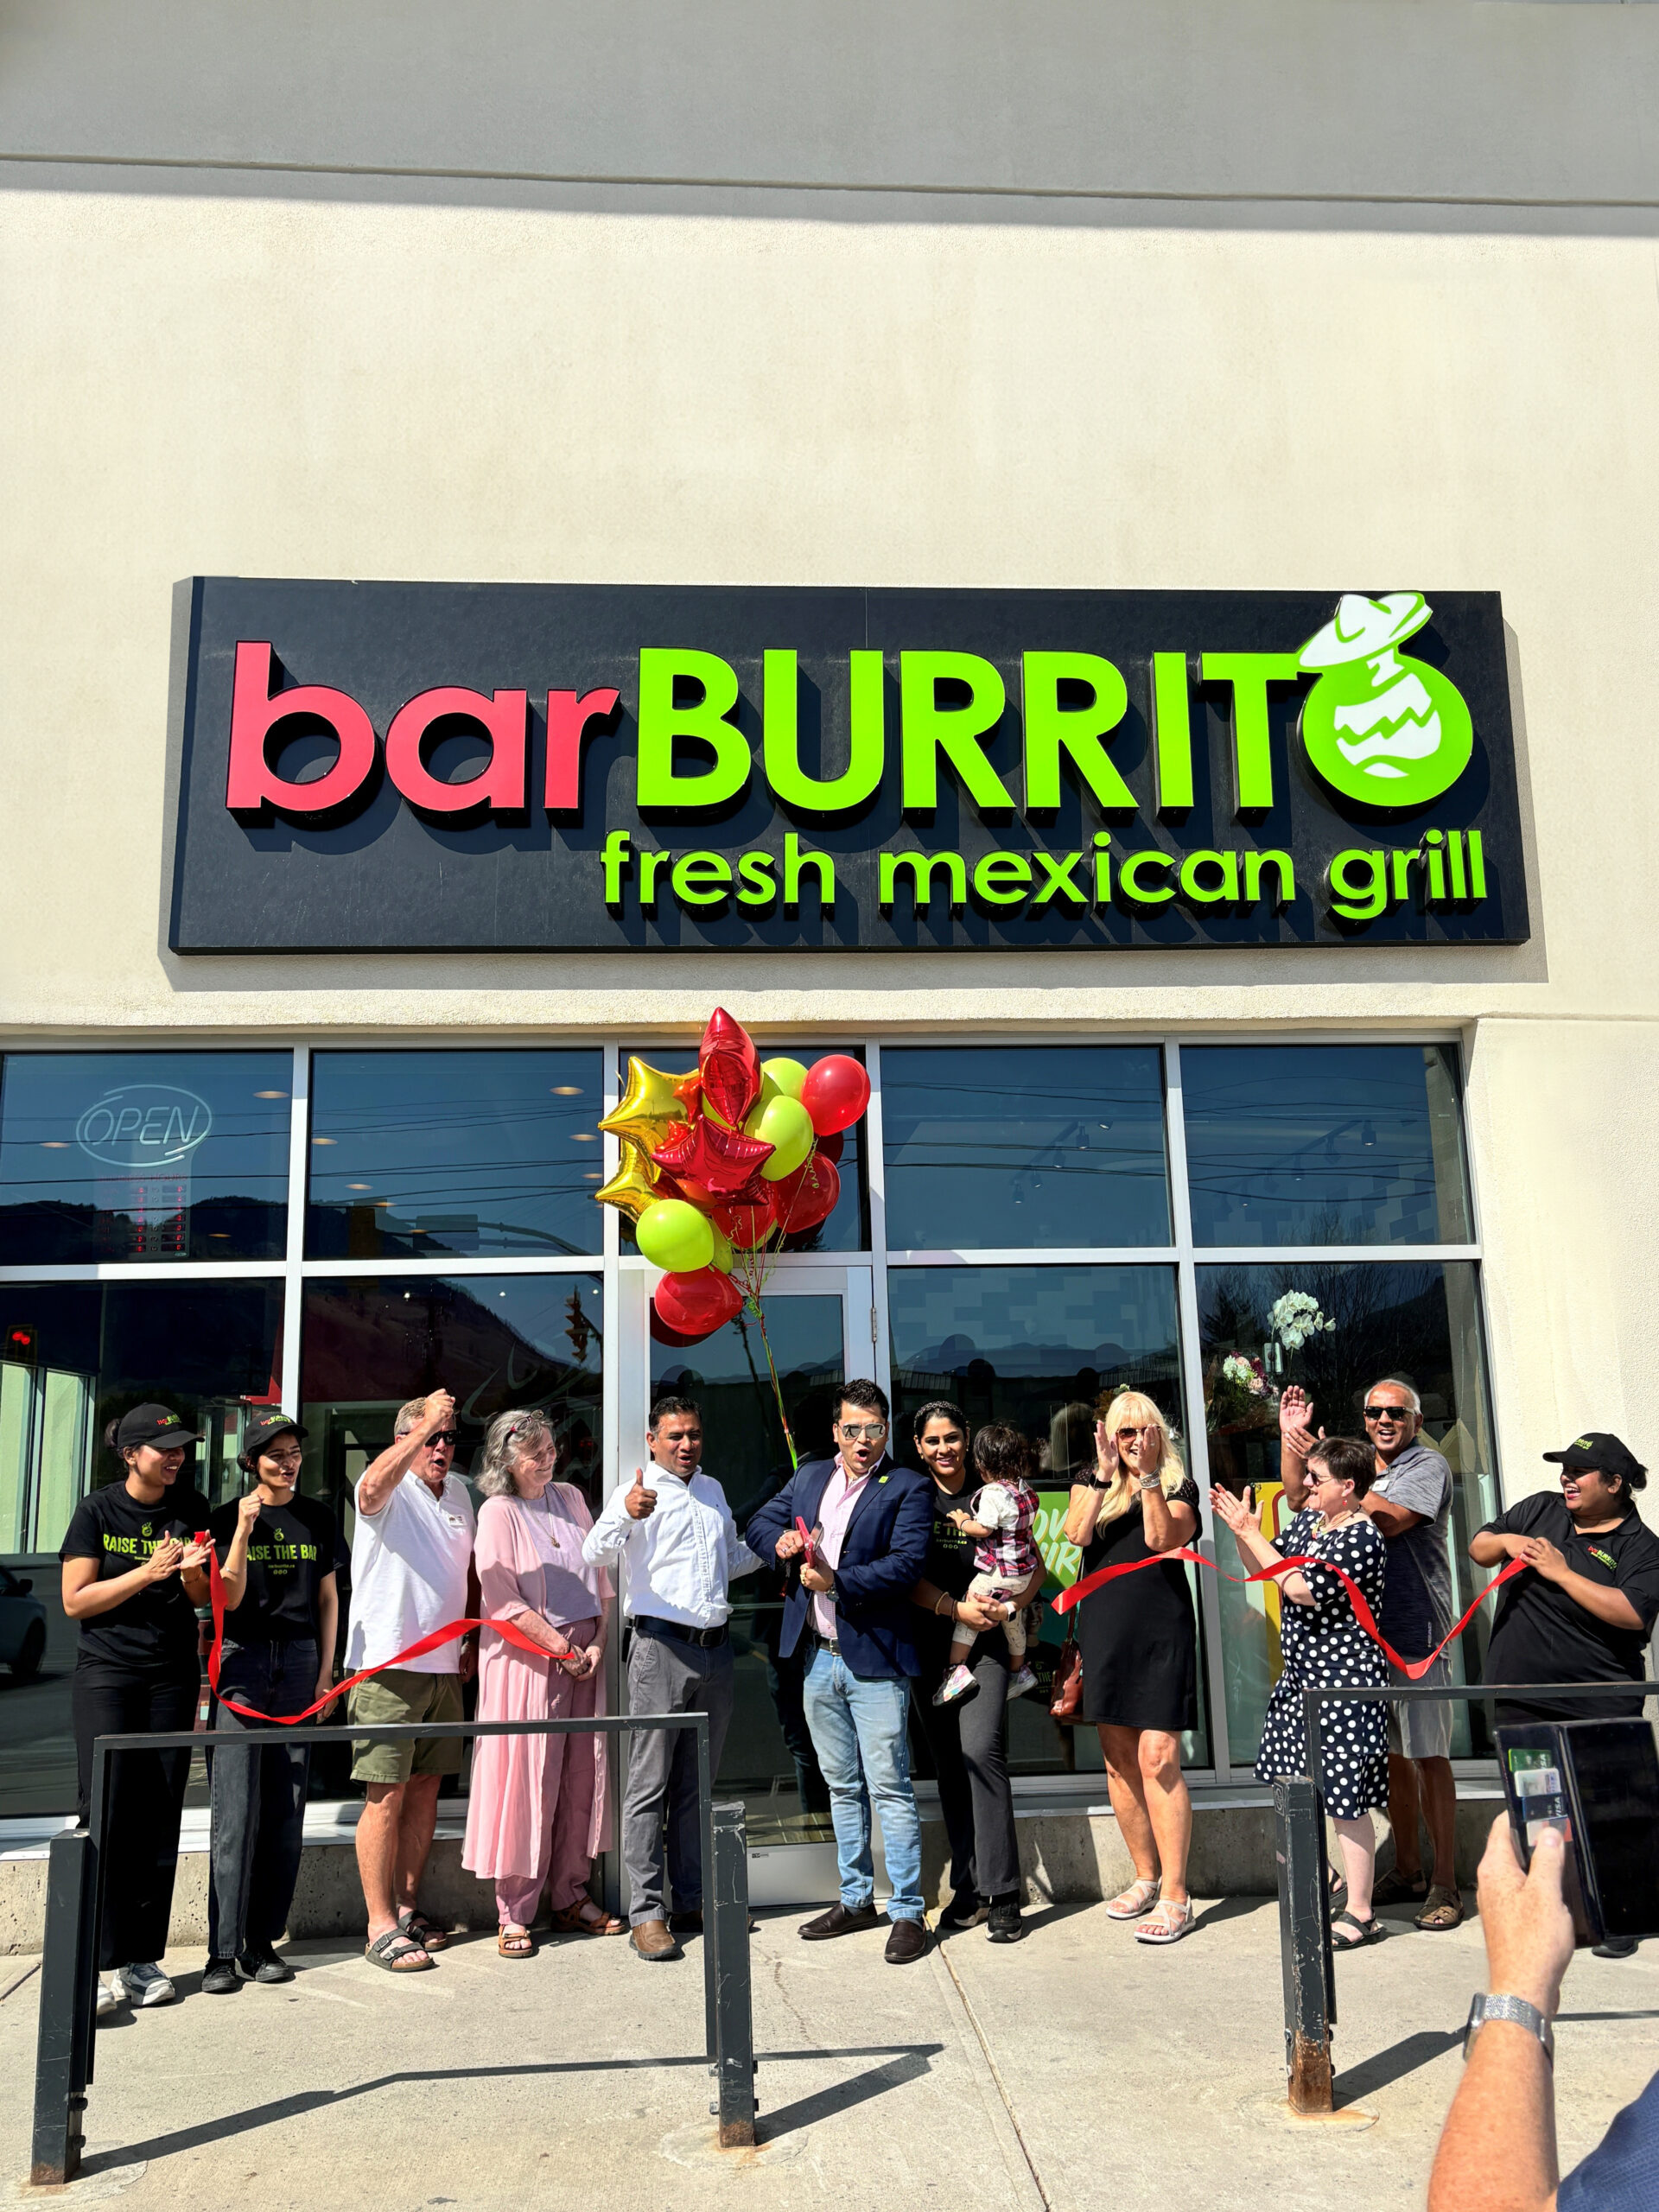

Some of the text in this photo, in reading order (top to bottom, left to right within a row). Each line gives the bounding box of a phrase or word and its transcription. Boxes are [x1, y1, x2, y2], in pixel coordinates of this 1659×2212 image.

[601, 828, 1488, 920] fresh mexican grill
[84, 1106, 200, 1147] OPEN
[103, 1533, 137, 1554] RAISE
[246, 1544, 317, 1561] AISE THE BAR
